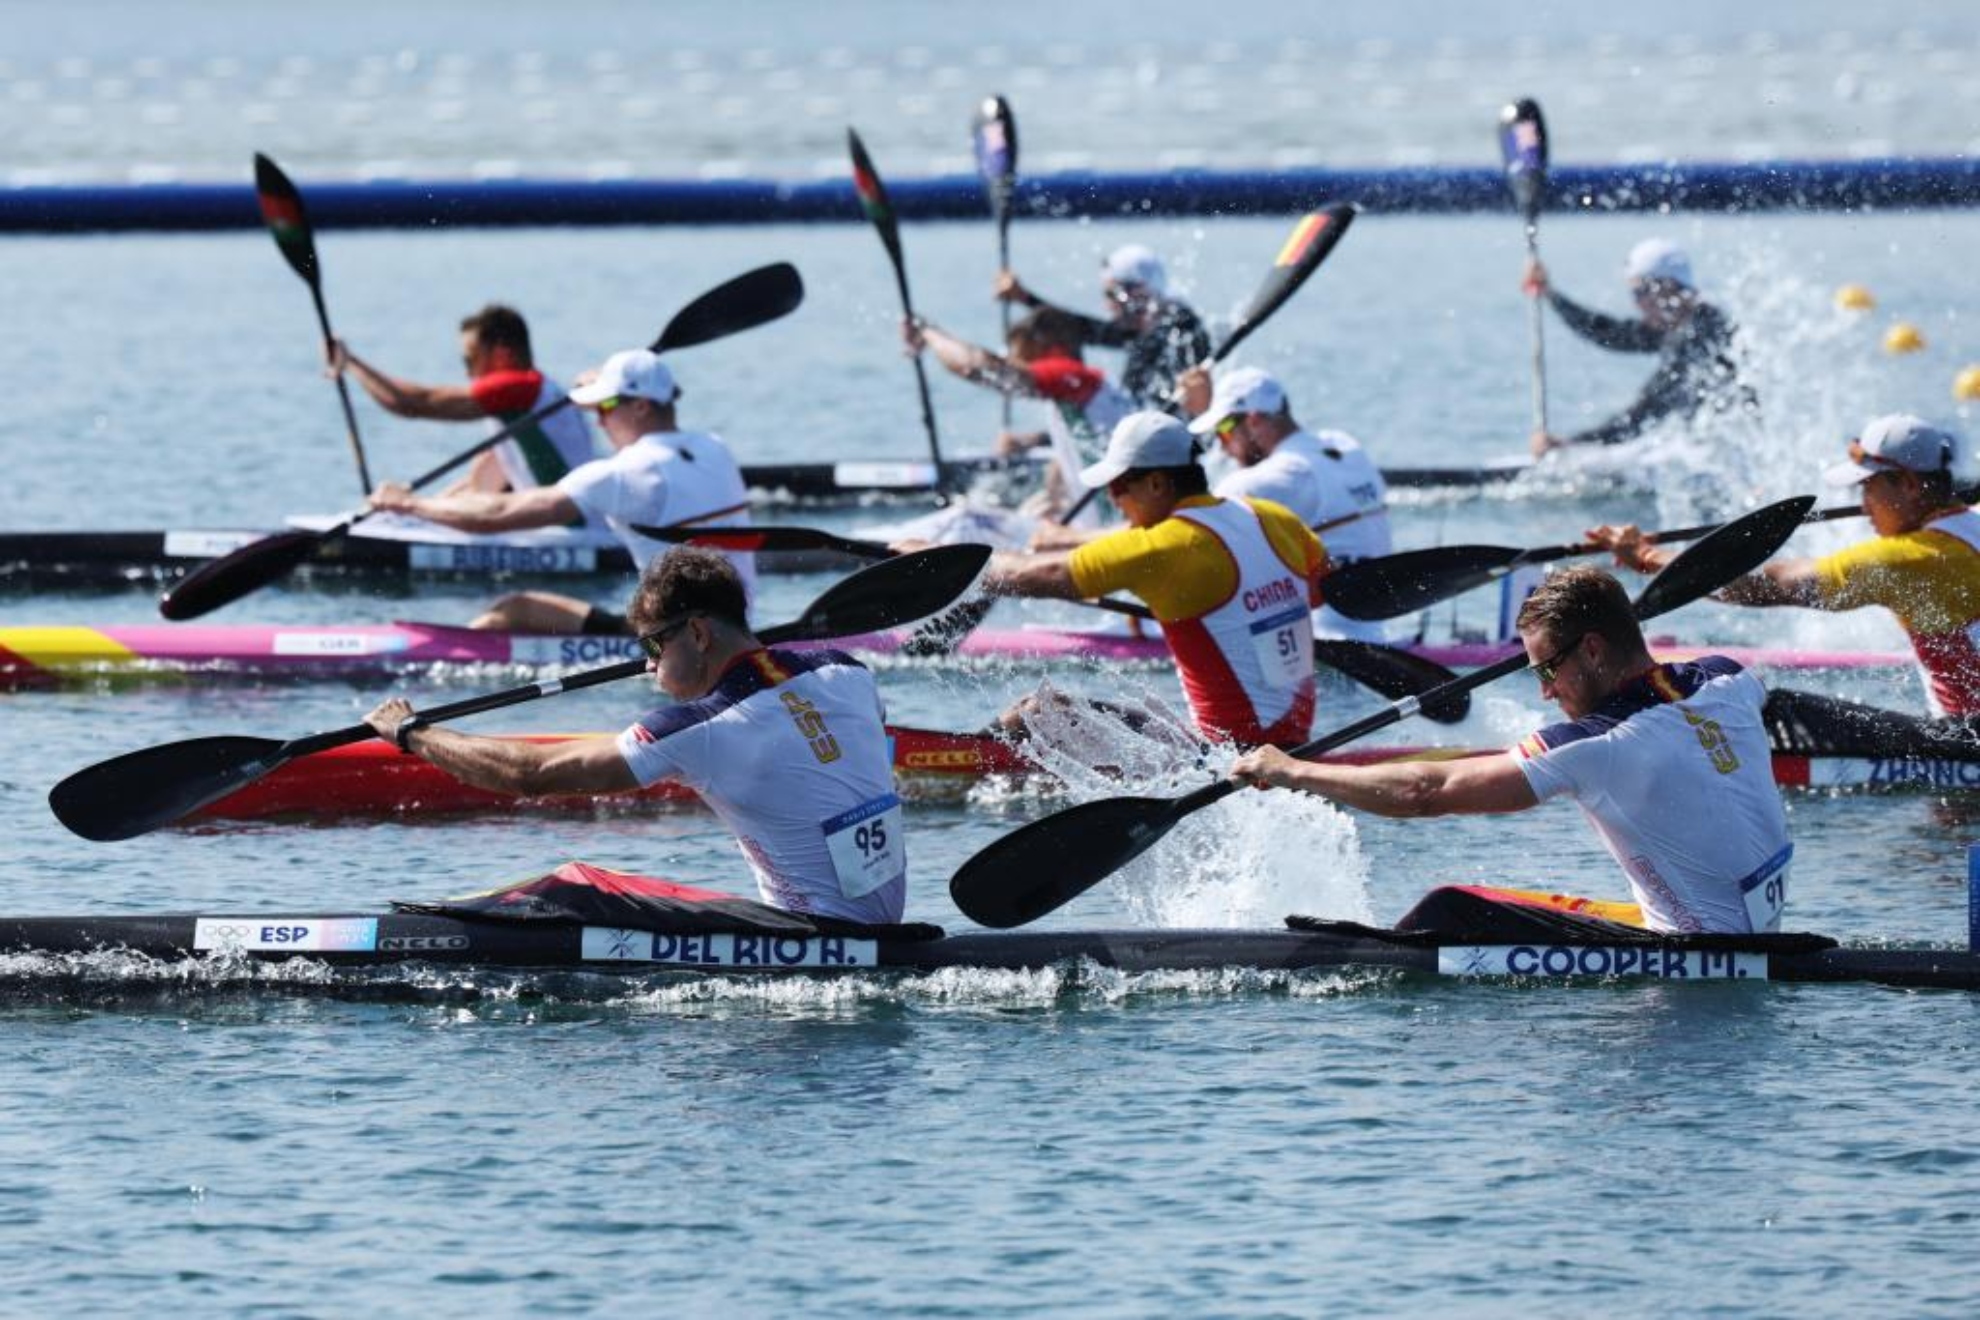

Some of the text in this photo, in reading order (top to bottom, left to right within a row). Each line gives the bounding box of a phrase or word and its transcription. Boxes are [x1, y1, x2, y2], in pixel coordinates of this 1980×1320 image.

[1243, 578, 1299, 613] CHINA
[1277, 628, 1297, 656] 51
[854, 819, 886, 857] 95
[1765, 874, 1784, 911] 91
[260, 926, 309, 943] ESP
[381, 937, 469, 950] NELO
[651, 931, 720, 963] DEL
[732, 933, 807, 965] RIO
[1506, 946, 1747, 977] COOPER M.
